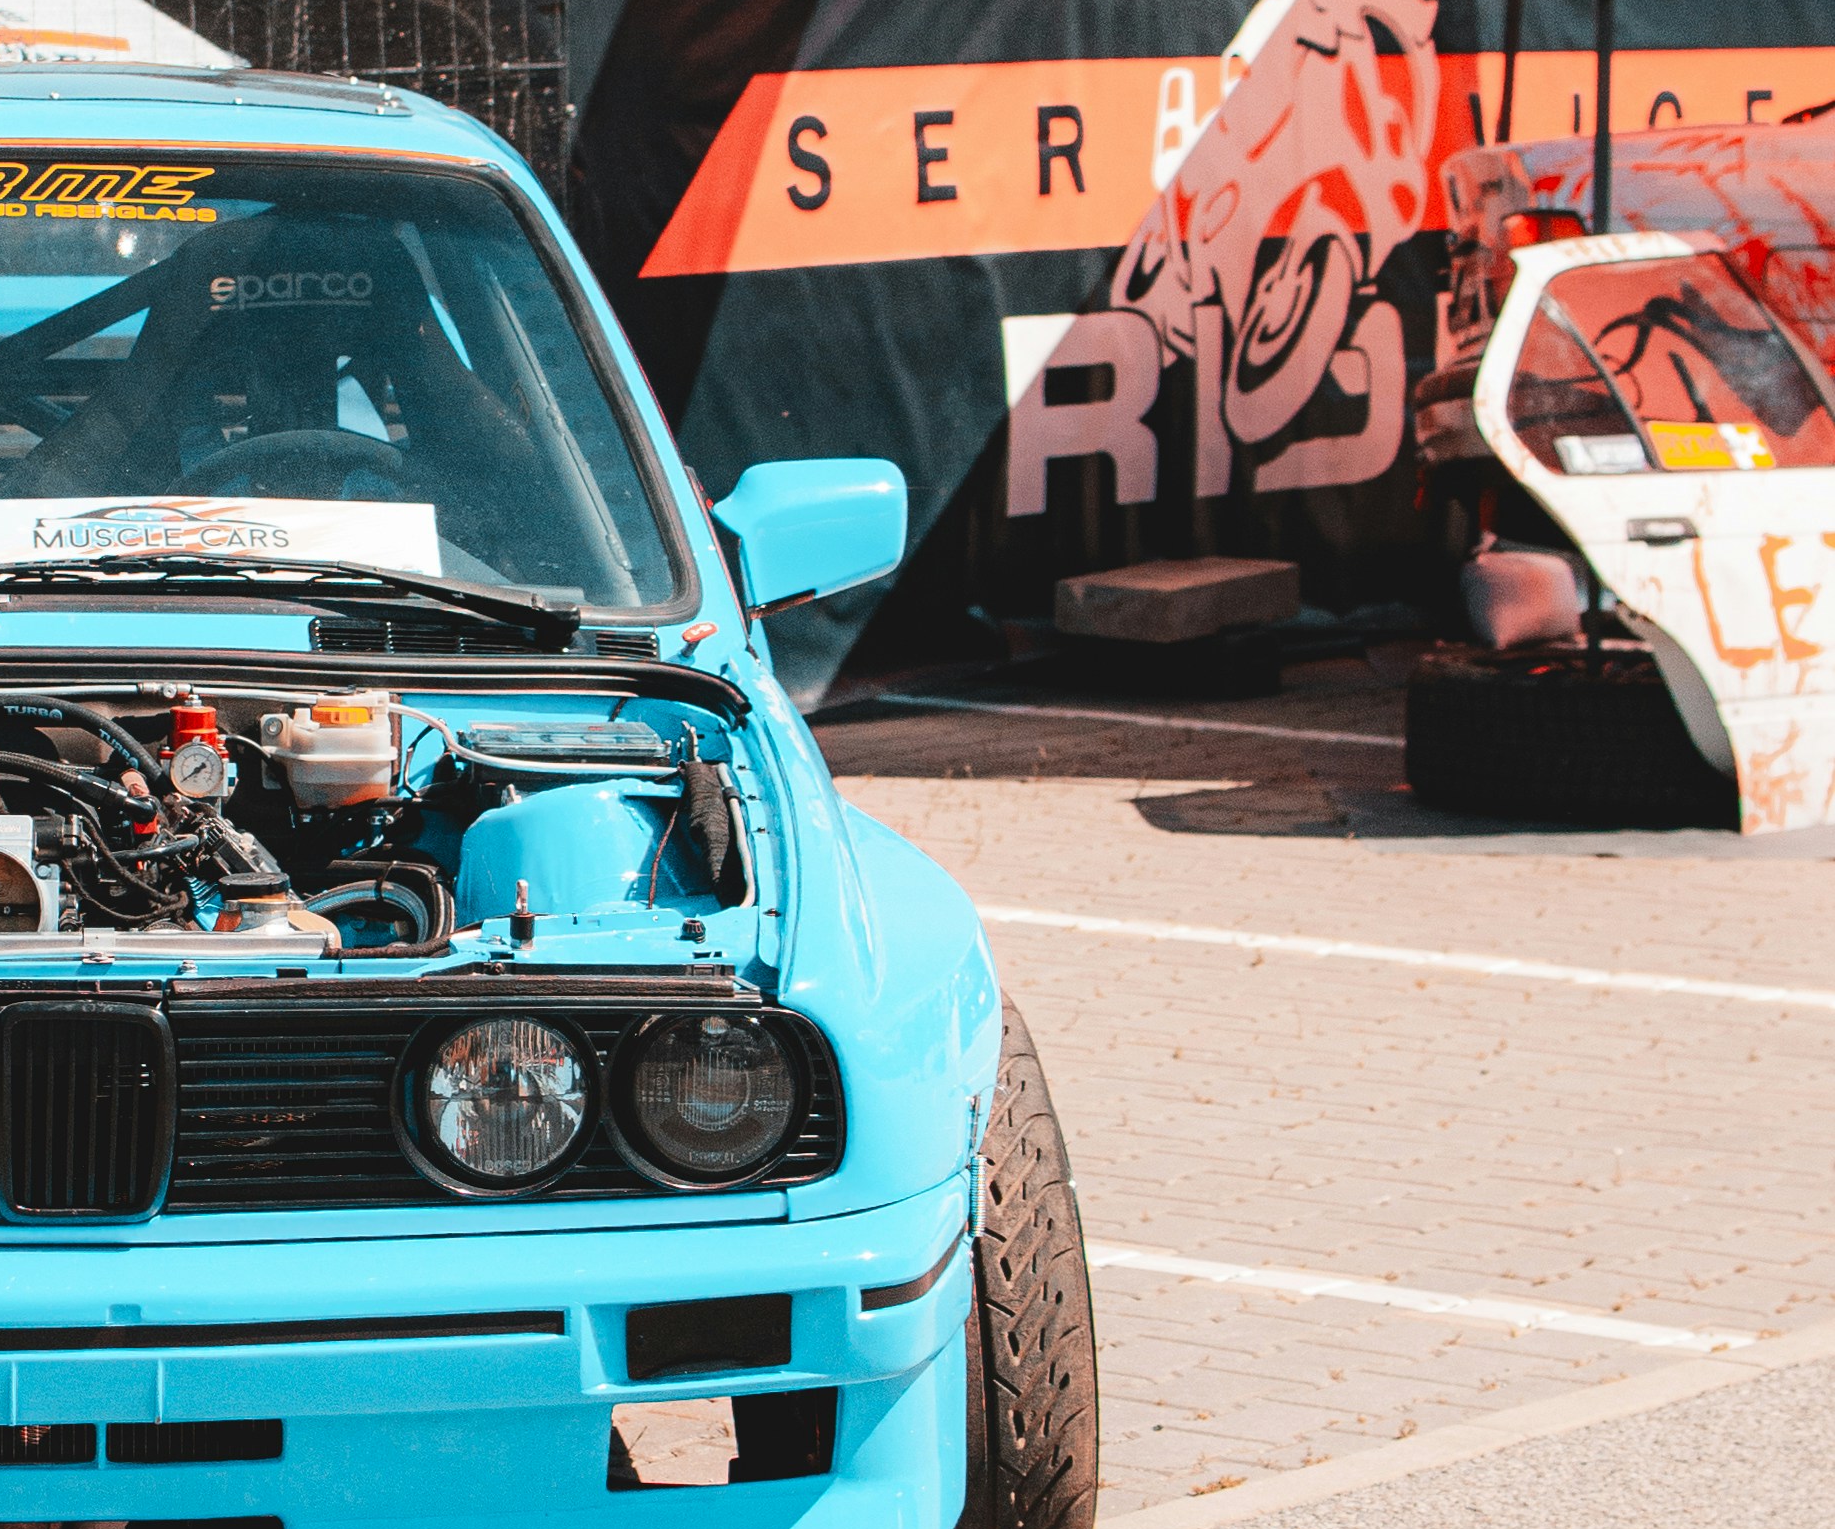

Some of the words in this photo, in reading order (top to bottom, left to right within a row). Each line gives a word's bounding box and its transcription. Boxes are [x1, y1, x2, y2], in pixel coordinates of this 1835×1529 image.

[35, 202, 218, 223] FIBERGLASS
[210, 271, 373, 310] sparco
[33, 527, 184, 549] MUSCLE
[200, 528, 290, 549] CARS
